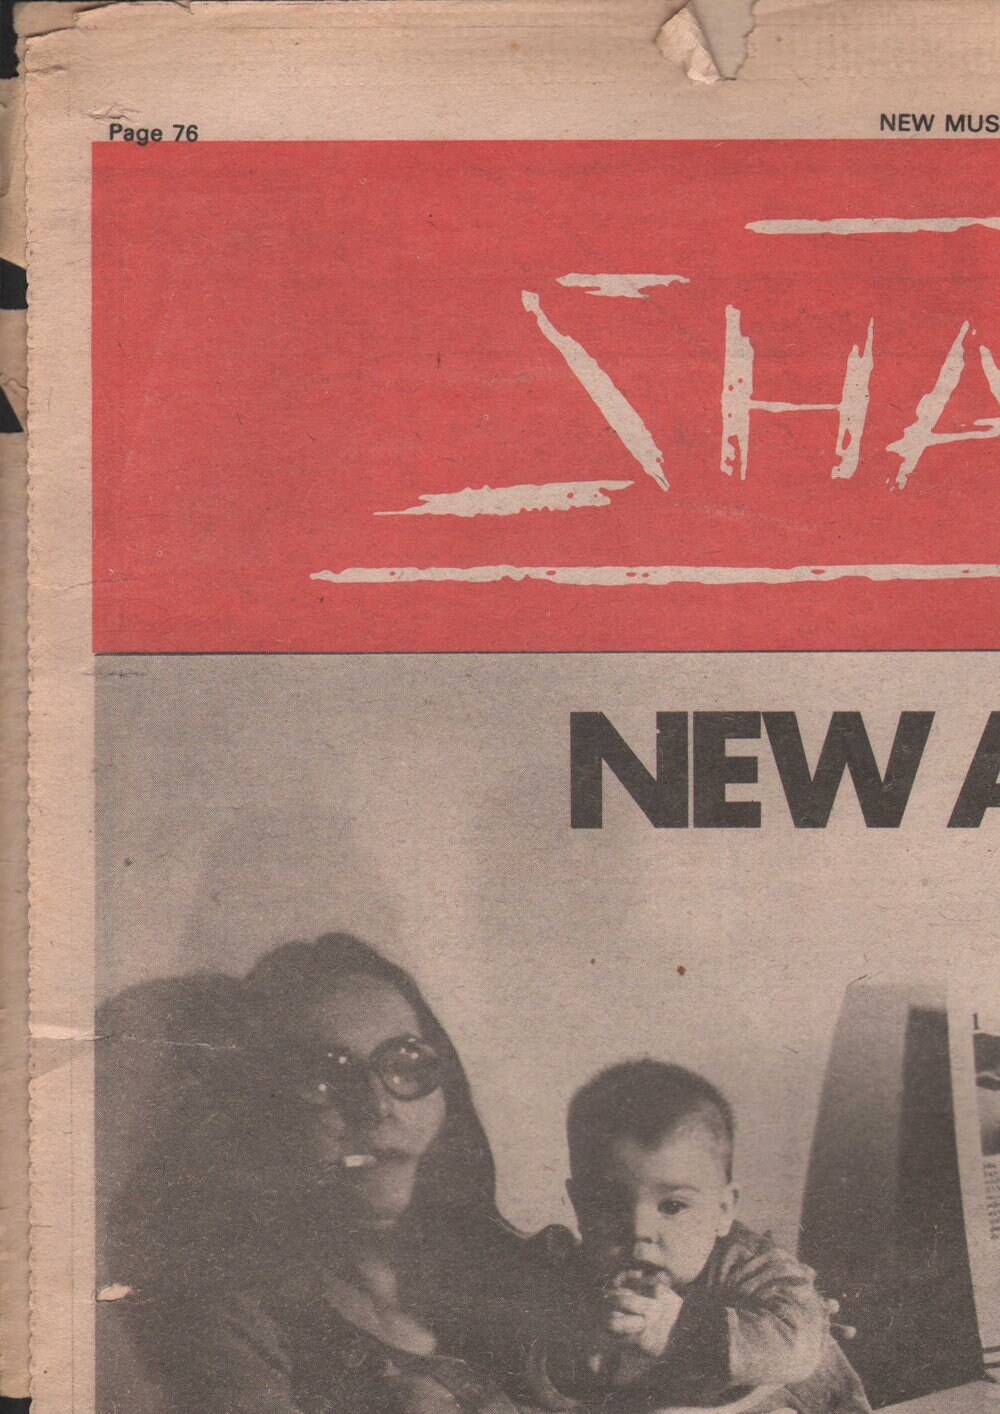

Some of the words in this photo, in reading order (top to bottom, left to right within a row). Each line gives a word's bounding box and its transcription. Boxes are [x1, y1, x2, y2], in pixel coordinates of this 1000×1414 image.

[879, 113, 935, 132] NEW
[109, 123, 163, 146] Page
[172, 124, 199, 142] 76
[569, 711, 938, 829] NEW
[972, 1012, 980, 1031] 1
